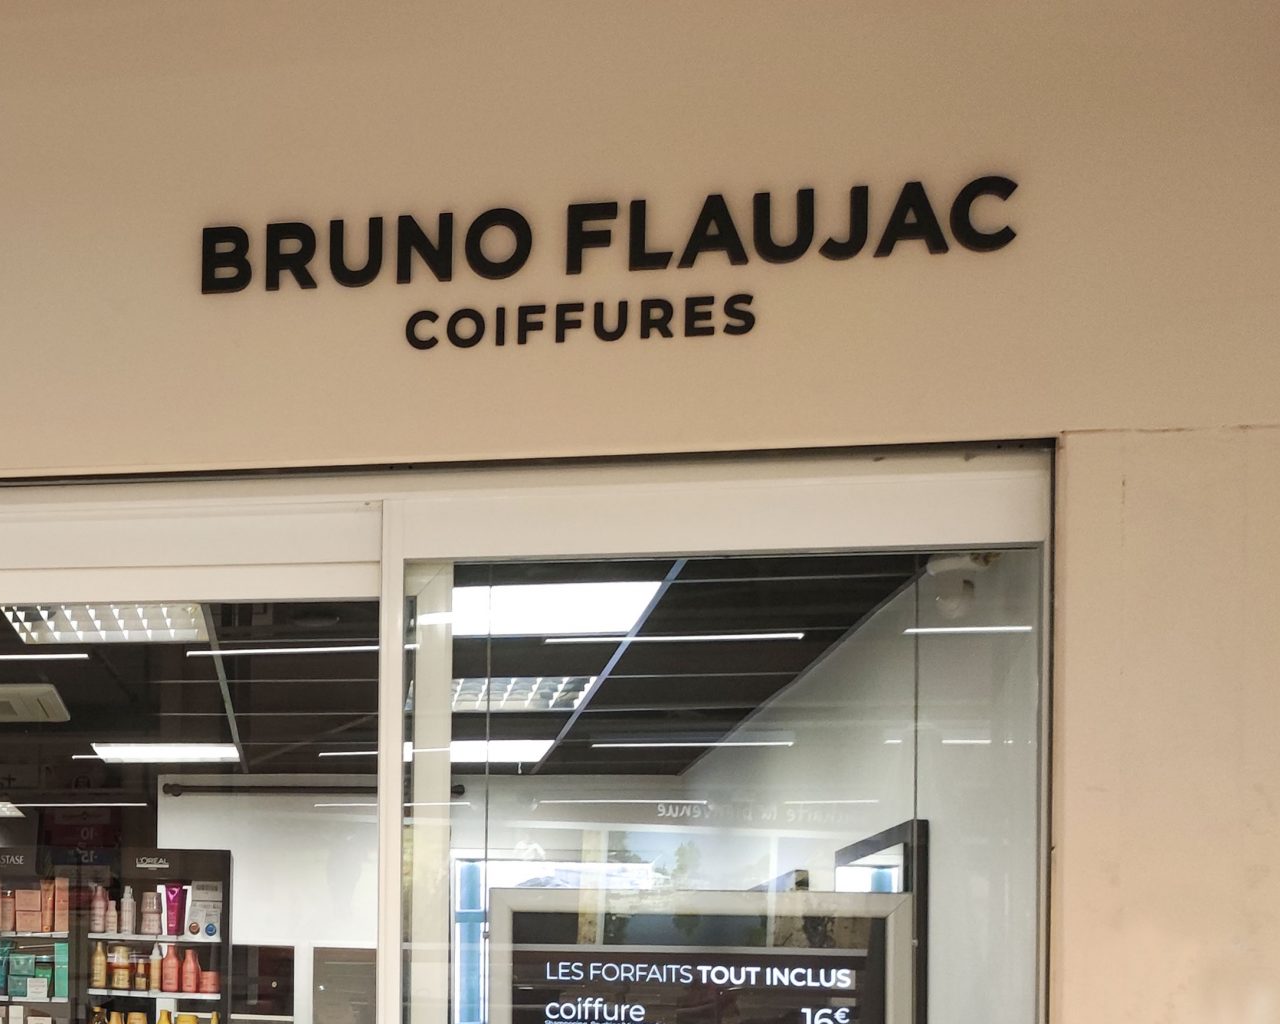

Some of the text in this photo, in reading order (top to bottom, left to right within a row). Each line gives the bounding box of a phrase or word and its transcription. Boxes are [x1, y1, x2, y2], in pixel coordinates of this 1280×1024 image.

[201, 175, 1019, 294] BRUNO FLAUJAC
[404, 293, 757, 351] COIFFURES
[546, 962, 851, 988] LES FORFAITS TOUT INCLUS
[545, 997, 646, 1021] coiffure
